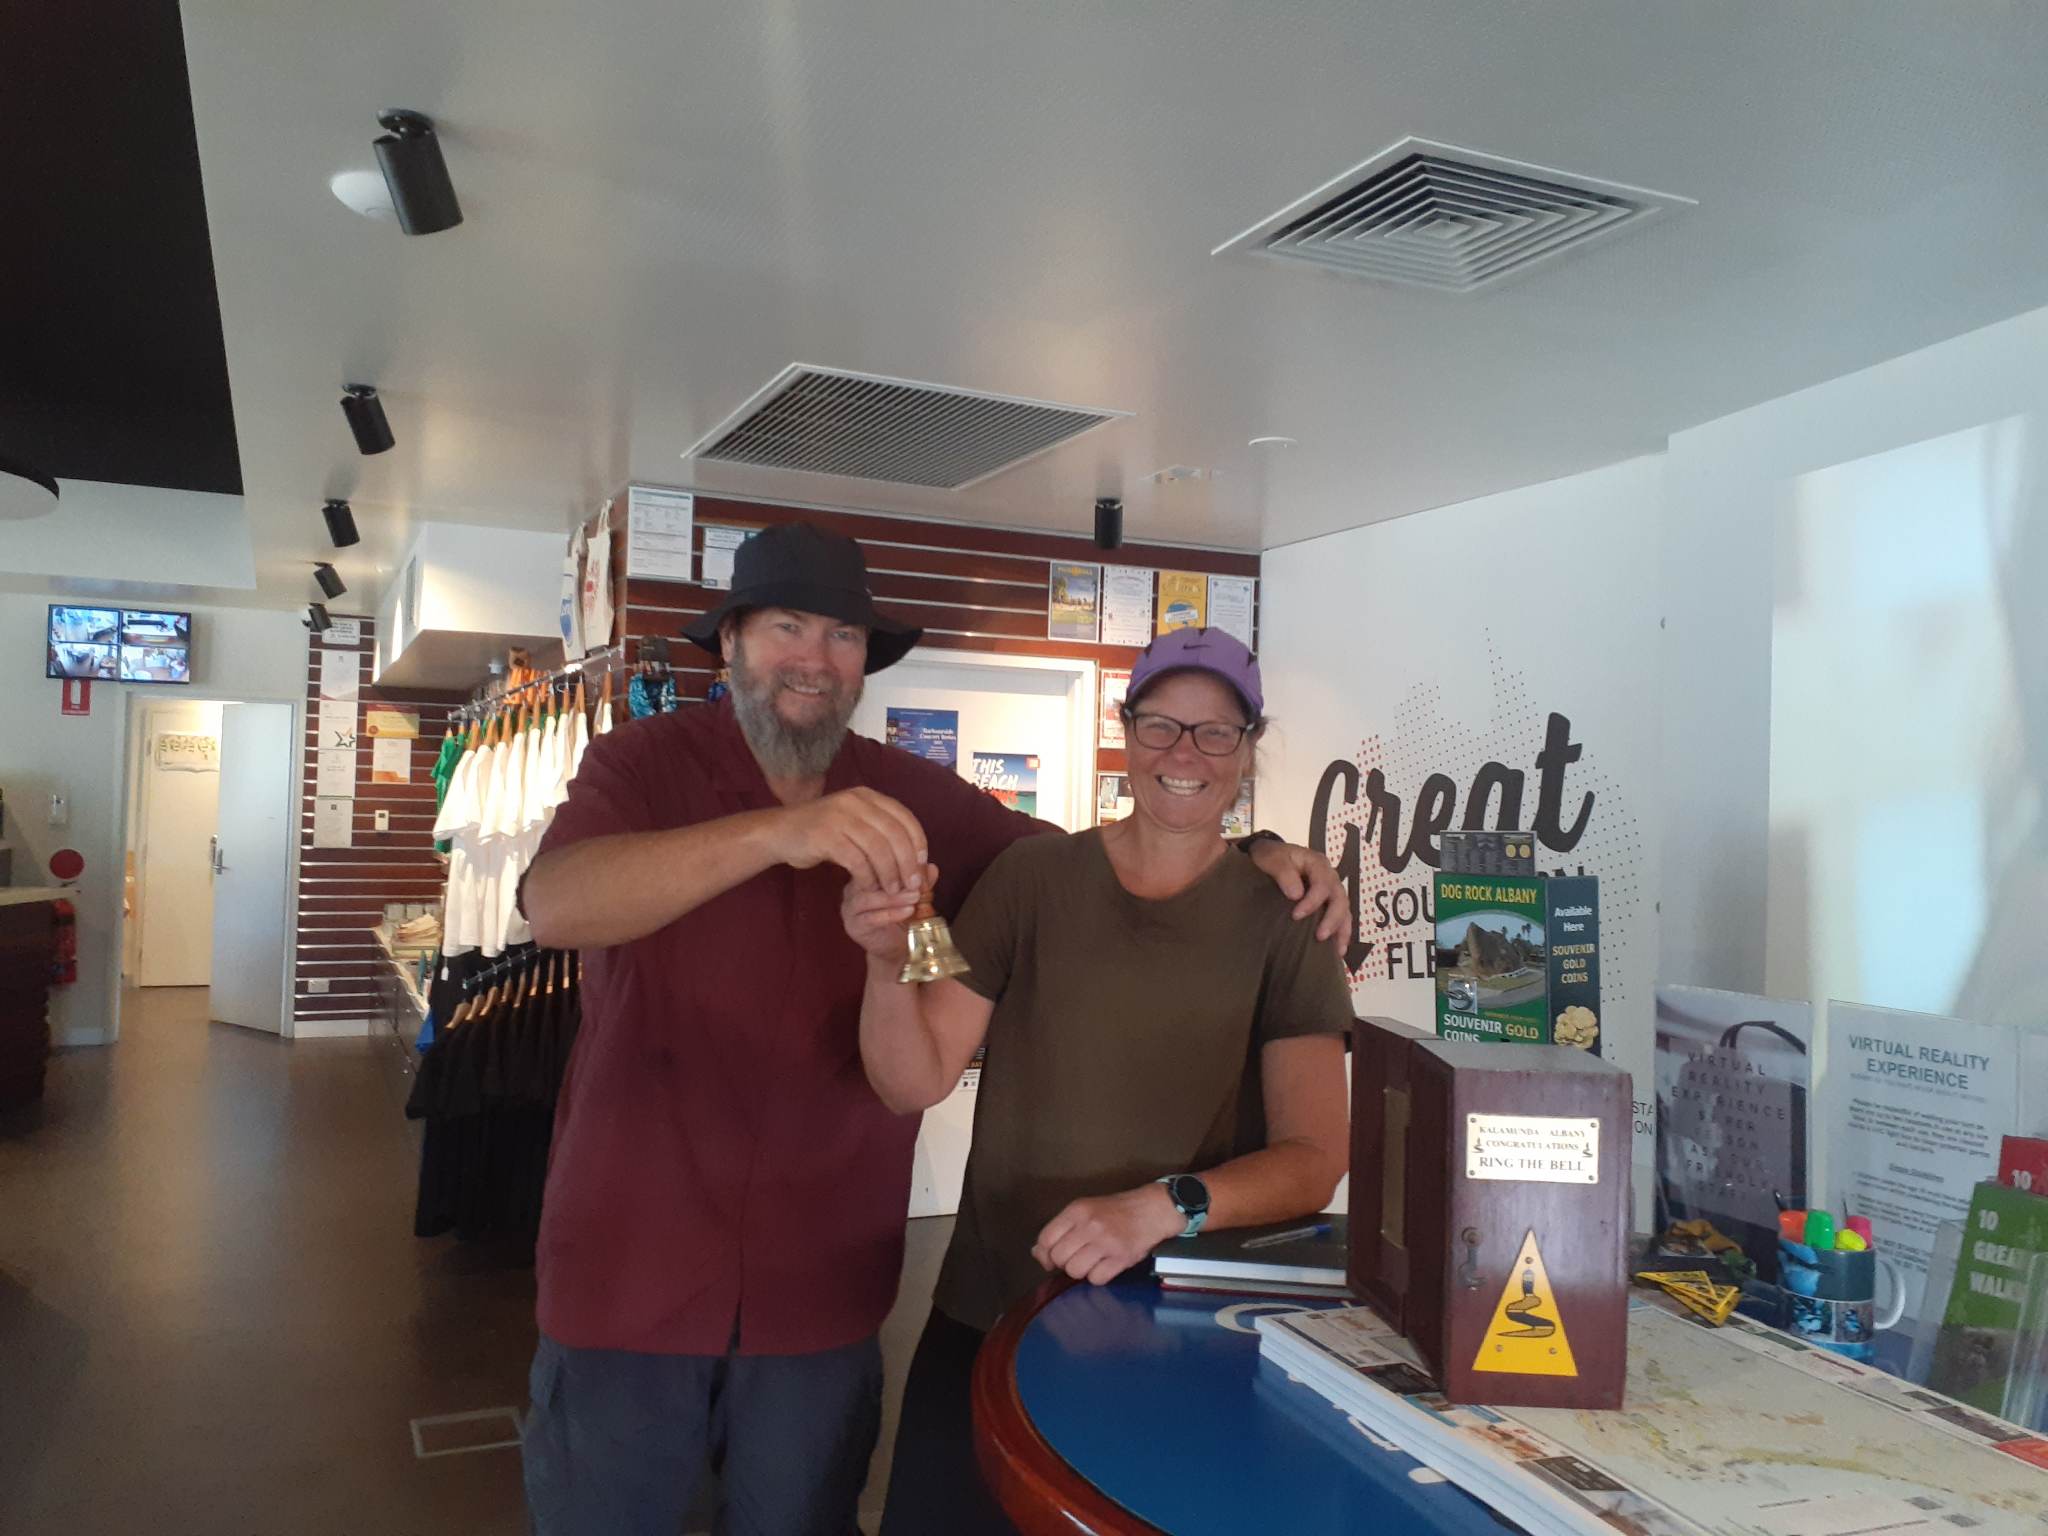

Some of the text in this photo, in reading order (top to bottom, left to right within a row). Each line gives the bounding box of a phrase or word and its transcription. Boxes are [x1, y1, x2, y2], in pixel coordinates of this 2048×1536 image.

[973, 758, 1005, 774] THIS
[1308, 712, 1595, 880] Great
[1441, 883, 1537, 904] DOG ROCK ALBANY
[1375, 885, 1436, 928] SOU
[1554, 906, 1592, 917] Available
[1563, 922, 1584, 932] Here
[1552, 944, 1595, 956] SOUVENIR
[1563, 959, 1586, 970] GOLD
[1561, 972, 1588, 984] COINS
[1443, 1013, 1503, 1034] SOUVENIR
[1506, 1023, 1539, 1039] GOLD
[1444, 1029, 1481, 1042] COINS
[1849, 1034, 1990, 1071] VIRTUAL REALITY
[1687, 1051, 1766, 1076] VIRTUAL
[1687, 1070, 1766, 1095] REALITY
[1867, 1058, 1969, 1090] EXPERIENCE
[1480, 1126, 1585, 1138] KALAMUNDA ALBANY
[1486, 1140, 1579, 1150] CONGRATULATIONS
[1480, 1156, 1584, 1171] RING THE BELL
[2011, 1169, 2032, 1190] 10
[1979, 1209, 1999, 1231] 10
